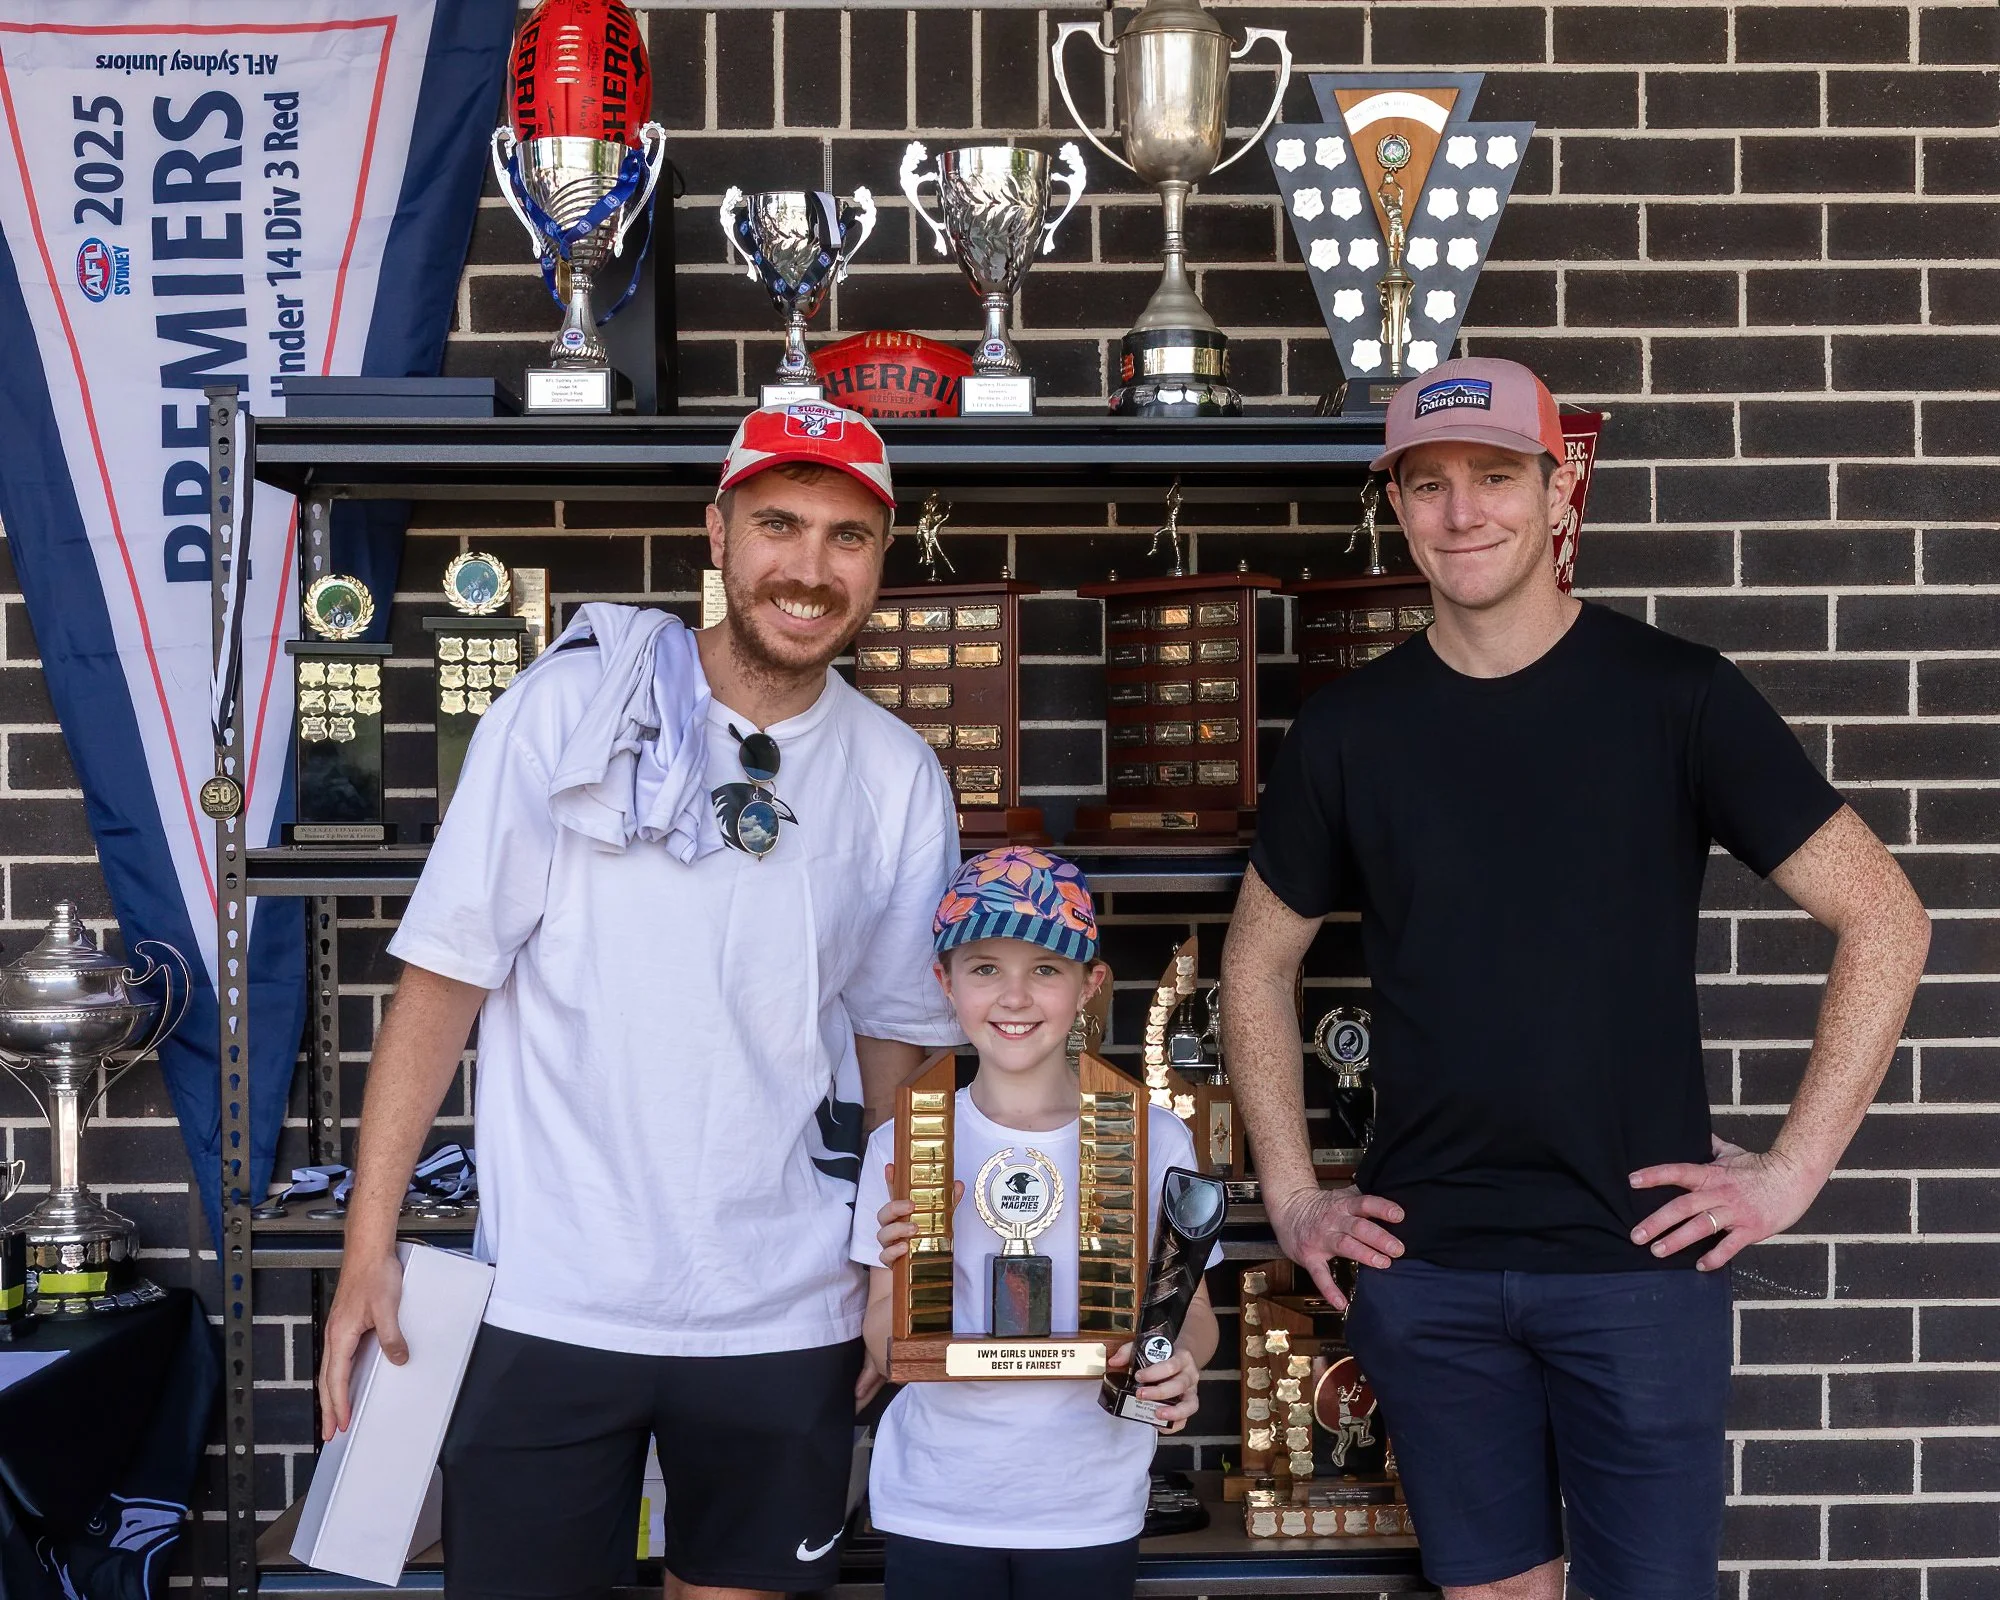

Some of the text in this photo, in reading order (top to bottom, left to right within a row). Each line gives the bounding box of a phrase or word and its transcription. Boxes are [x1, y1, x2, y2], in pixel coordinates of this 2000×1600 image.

[95, 48, 279, 77] AFL Sydney Juniors
[263, 91, 300, 152] Red
[72, 95, 124, 226] 2025
[263, 160, 300, 180] 3
[263, 186, 302, 240] Div
[84, 243, 104, 297] AFL
[112, 244, 131, 295] SYDNEY
[266, 247, 302, 287] 14
[796, 404, 836, 417] SWANS
[1420, 394, 1486, 415] patagonia
[208, 786, 231, 804] 50
[1000, 1201, 1040, 1210] MAGPIES
[977, 1348, 1076, 1359] IWM GIRLS UNDER 9'S
[991, 1360, 1062, 1370] BEST & FAIREST
